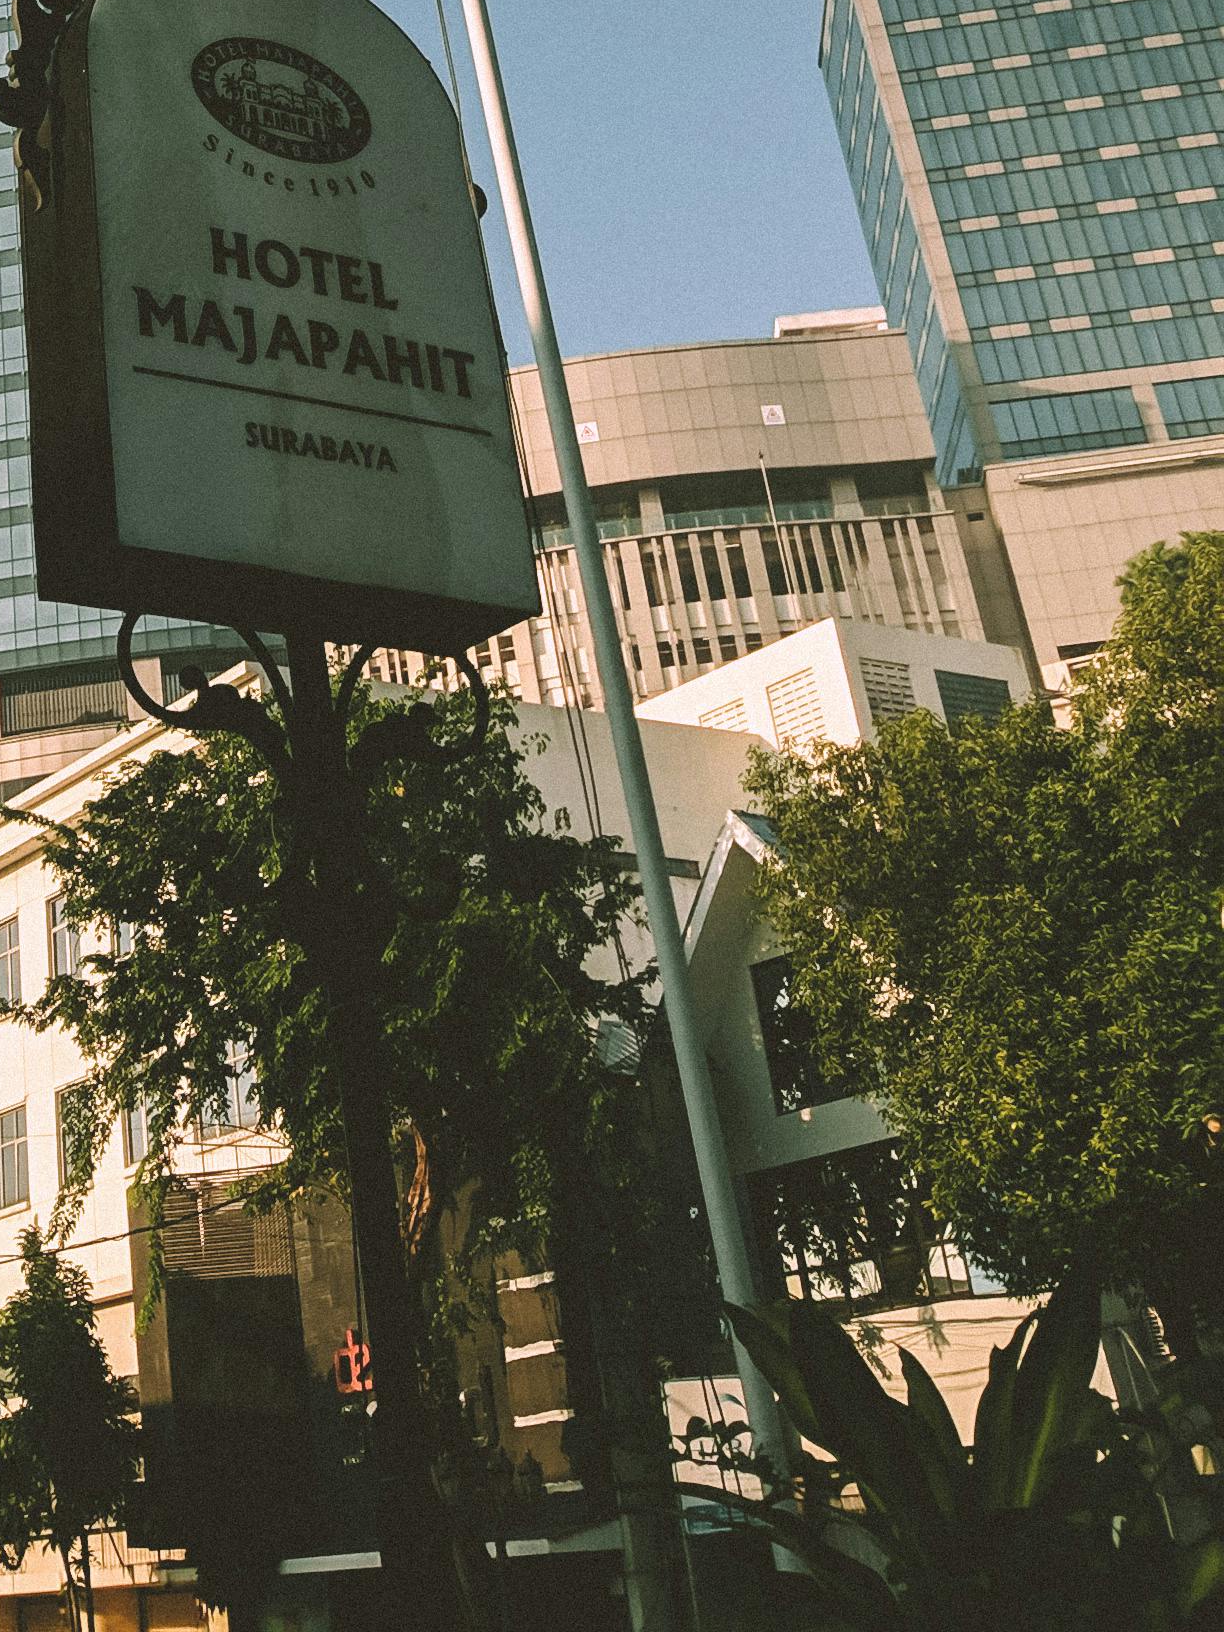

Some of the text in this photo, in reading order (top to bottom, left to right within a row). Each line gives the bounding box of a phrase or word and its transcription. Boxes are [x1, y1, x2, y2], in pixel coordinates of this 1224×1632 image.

[202, 133, 376, 197] Since 1910
[208, 226, 399, 311] HOTEL
[131, 286, 475, 399] MAJAPAHIT
[245, 420, 398, 473] SURABAYA
